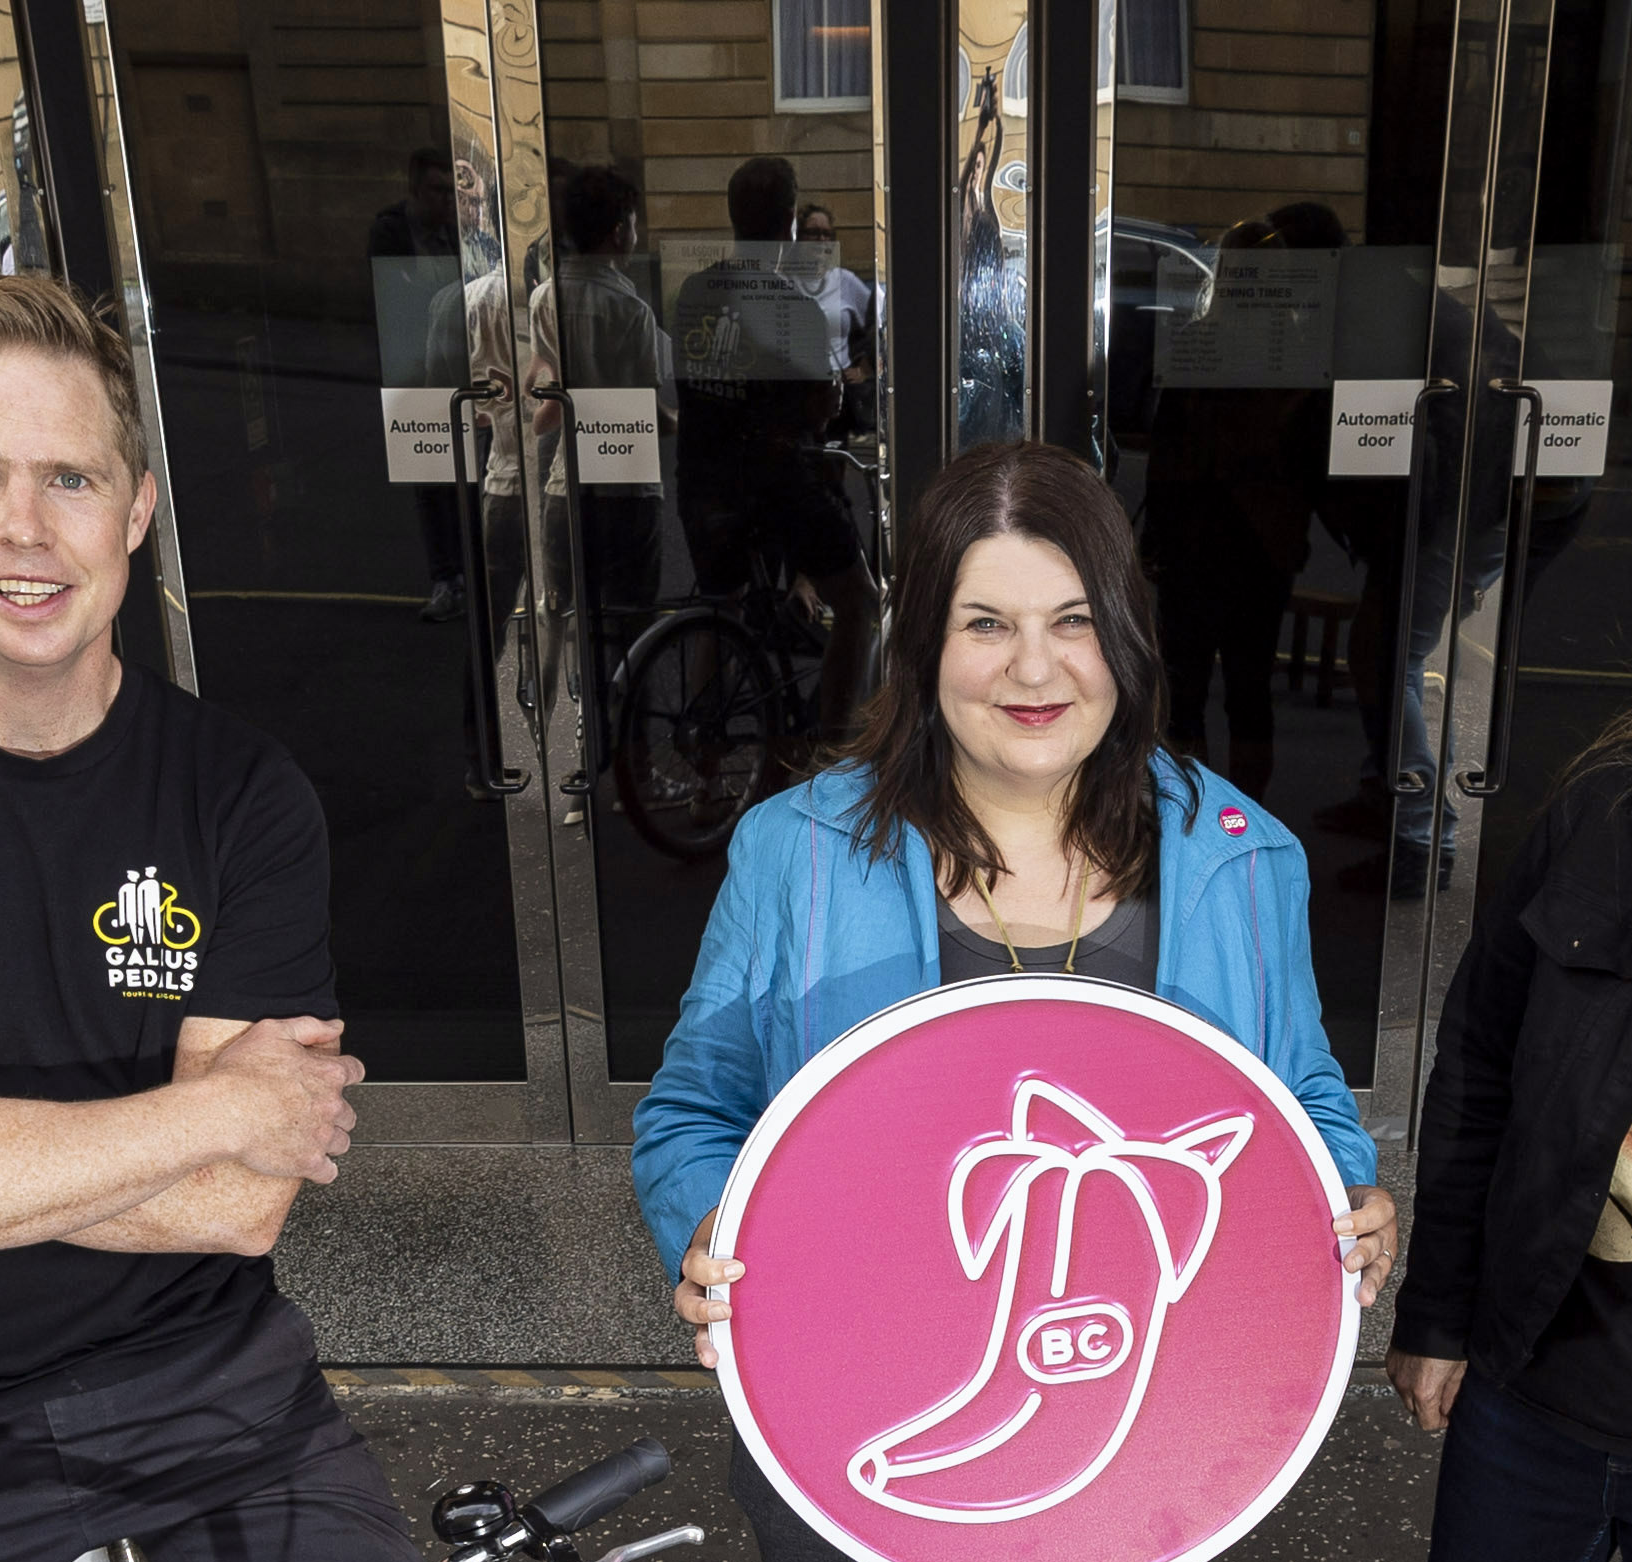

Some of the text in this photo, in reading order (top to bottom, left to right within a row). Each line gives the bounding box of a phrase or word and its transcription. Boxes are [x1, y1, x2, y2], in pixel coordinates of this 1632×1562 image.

[707, 280, 758, 290] OPENING
[1258, 287, 1293, 298] TIMES
[390, 420, 470, 433] Automac
[575, 420, 654, 434] Automatic
[413, 440, 450, 454] door
[1358, 433, 1395, 447] door
[1543, 433, 1581, 447] door
[598, 441, 634, 455] door
[1040, 1324, 1111, 1367] BC
